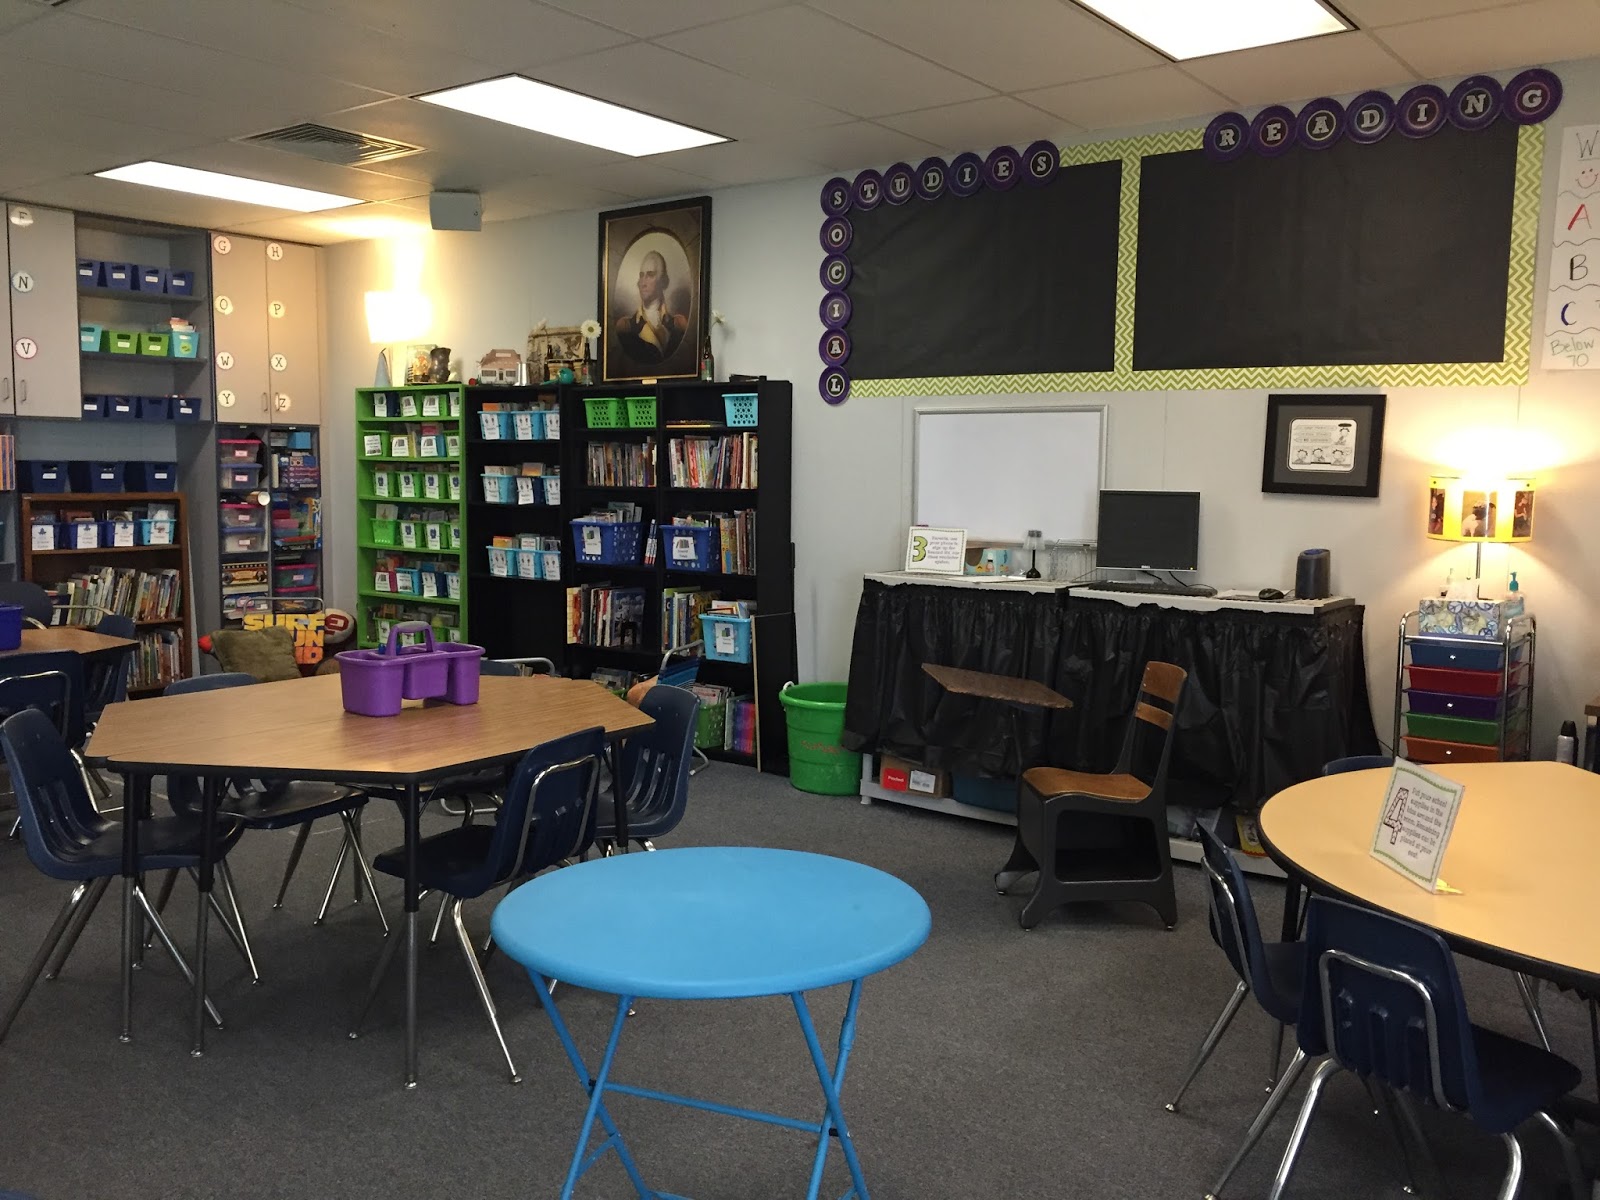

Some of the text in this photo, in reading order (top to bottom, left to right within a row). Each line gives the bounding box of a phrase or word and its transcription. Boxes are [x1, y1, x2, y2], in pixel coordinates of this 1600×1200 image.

[1219, 90, 1542, 146] READING
[833, 156, 1047, 205] STUDIES
[1567, 203, 1592, 231] A
[1569, 254, 1588, 281] B
[1561, 301, 1577, 326] C
[1550, 337, 1594, 356] Below
[1566, 353, 1589, 367] 70
[912, 535, 928, 562] 3
[244, 614, 325, 630] SURF
[1411, 799, 1429, 811] supplies
[1435, 808, 1443, 817] the
[1432, 796, 1448, 807] school
[1383, 787, 1409, 845] 4
